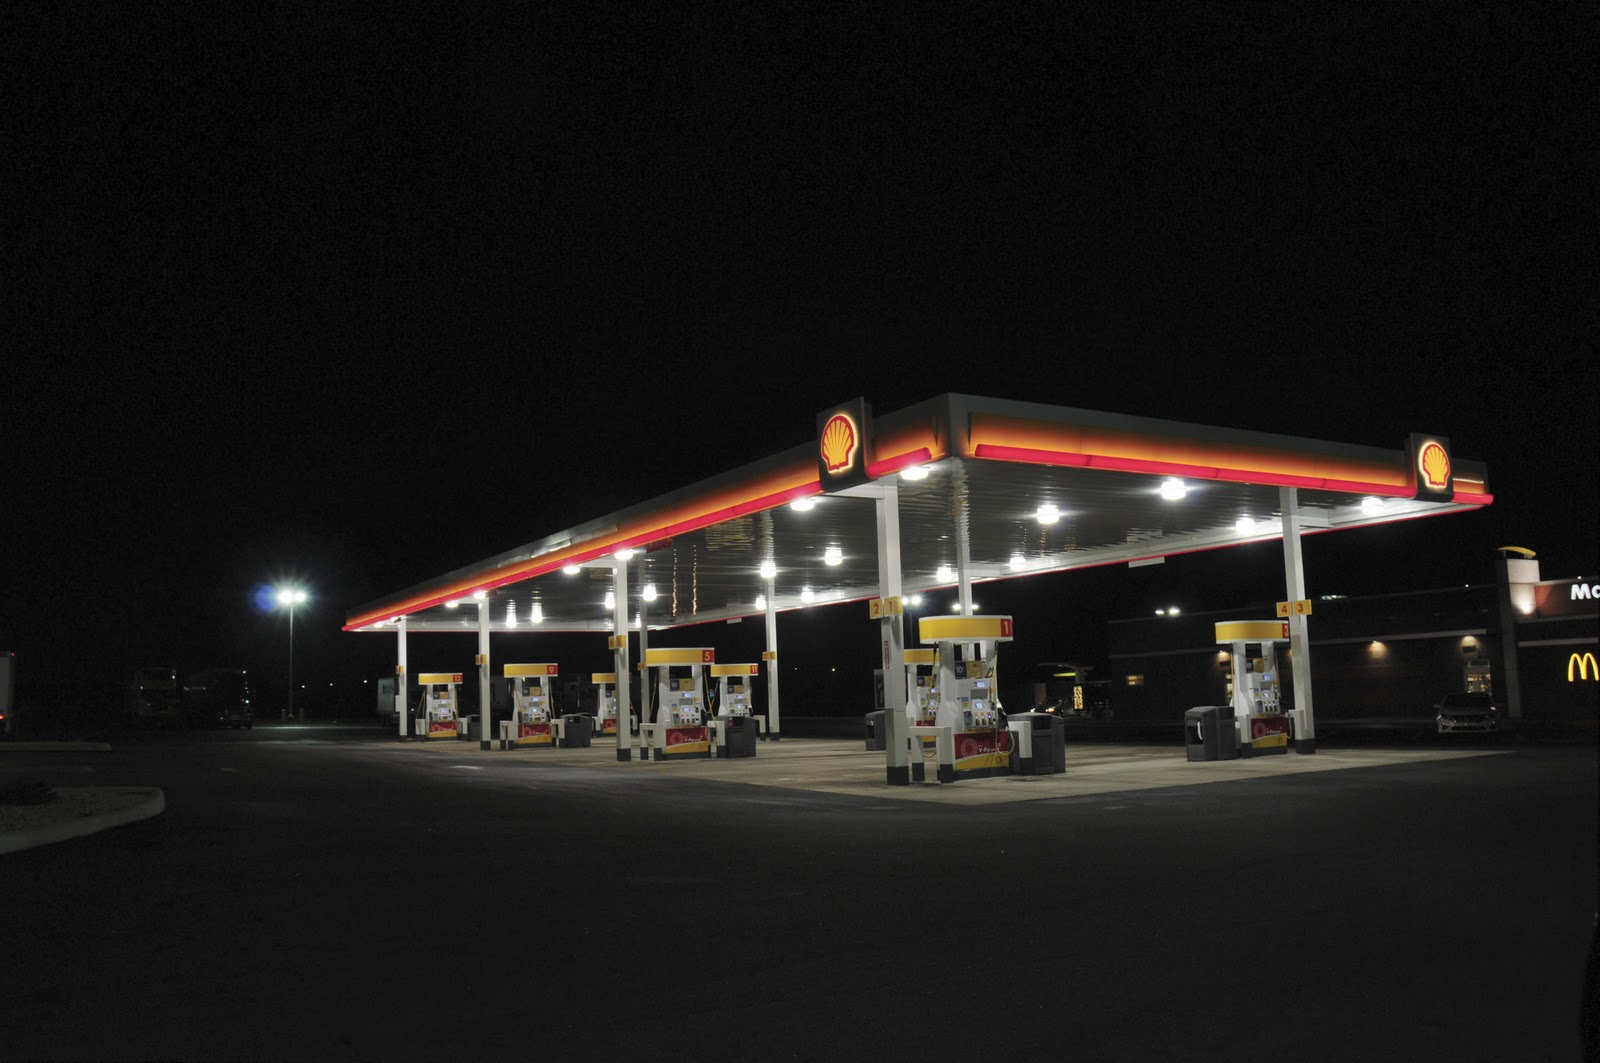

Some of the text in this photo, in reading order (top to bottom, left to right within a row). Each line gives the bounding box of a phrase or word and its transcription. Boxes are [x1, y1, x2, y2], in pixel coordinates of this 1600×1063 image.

[873, 603, 879, 614] 2
[888, 601, 892, 612] 1
[1281, 605, 1288, 613] 4
[1297, 603, 1304, 612] 3
[1003, 621, 1009, 634] 1
[1284, 625, 1289, 637] 3
[704, 651, 710, 661] 5
[548, 666, 554, 674] 9
[752, 665, 758, 673] 11
